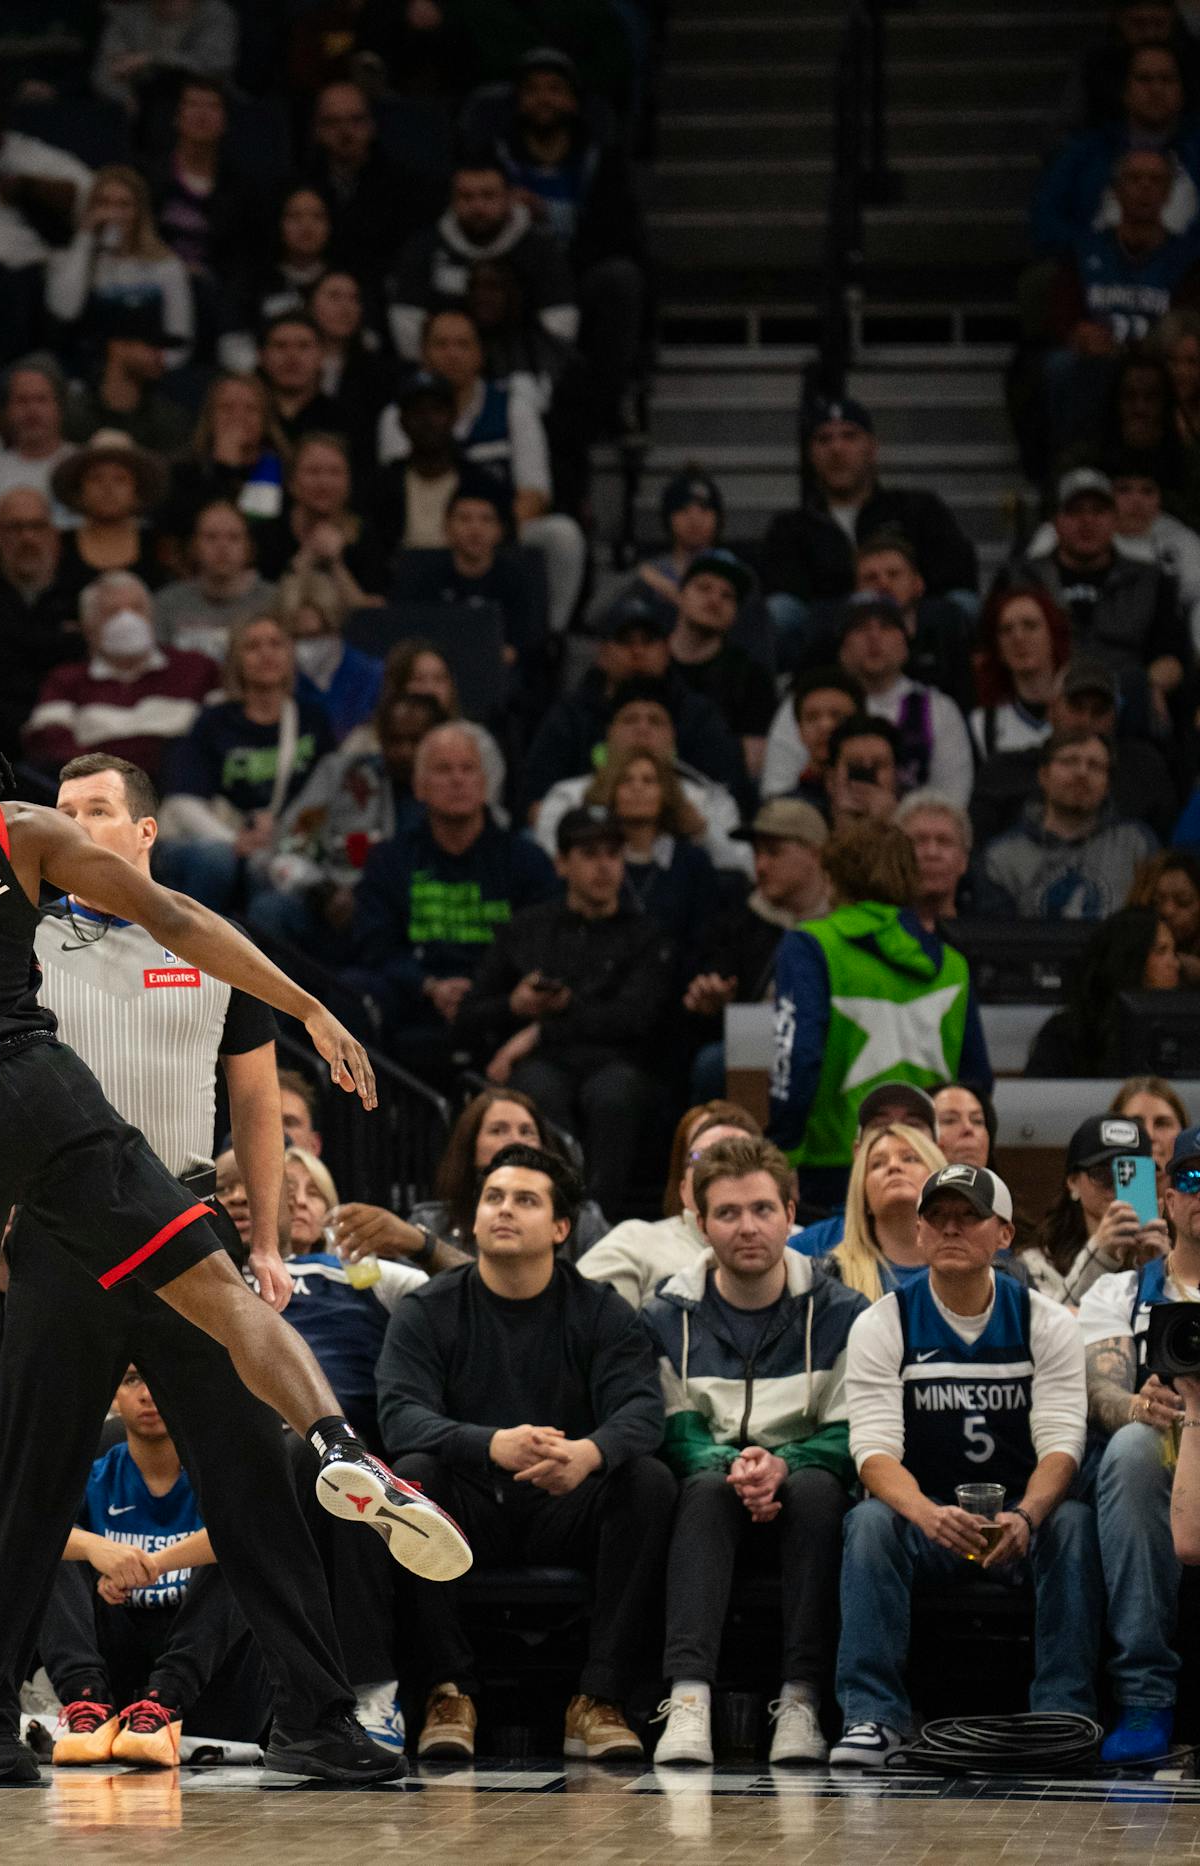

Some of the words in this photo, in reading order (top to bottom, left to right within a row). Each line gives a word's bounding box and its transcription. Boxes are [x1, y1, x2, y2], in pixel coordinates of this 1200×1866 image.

[148, 972, 197, 984] Emirates
[913, 1383, 1027, 1411] MINNESOTA
[963, 1415, 996, 1464] 5
